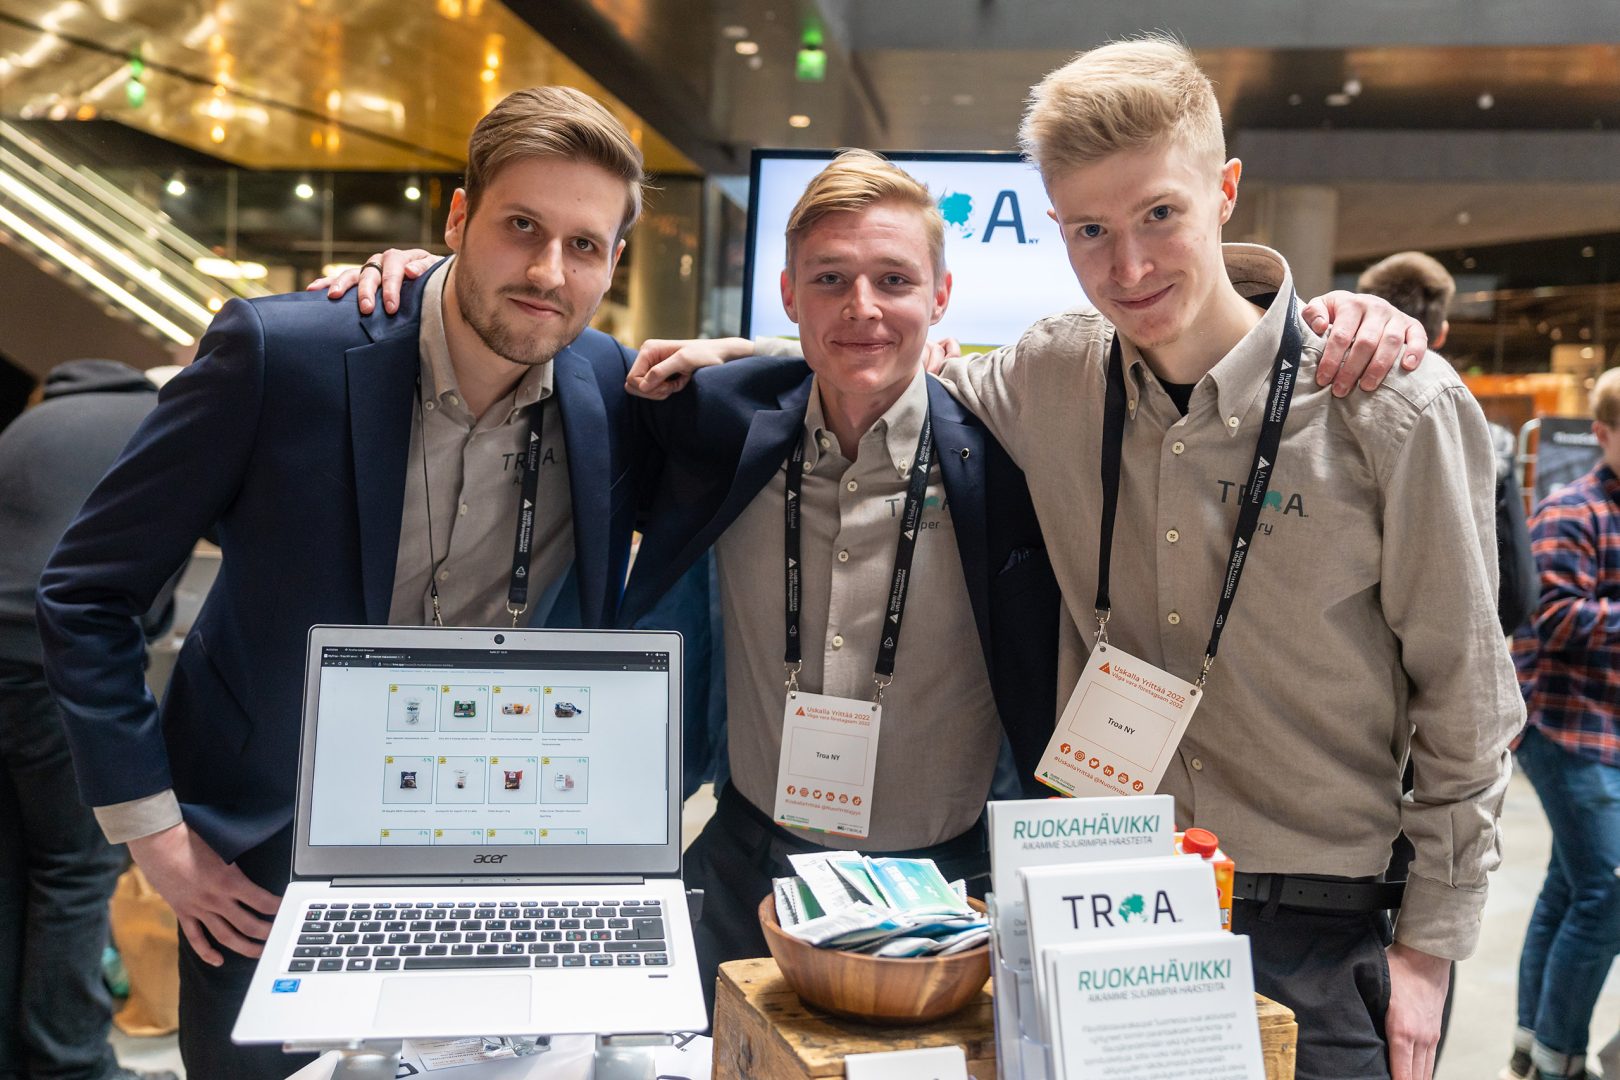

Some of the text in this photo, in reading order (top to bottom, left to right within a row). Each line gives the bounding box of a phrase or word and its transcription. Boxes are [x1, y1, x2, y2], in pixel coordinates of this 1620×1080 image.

[502, 447, 556, 471] TRA
[1252, 480, 1264, 504] Finland
[1114, 665, 1140, 681] Uskalla
[1167, 691, 1185, 703] 2022
[1169, 700, 1183, 709] 2022
[1107, 717, 1136, 735] Troa NY
[816, 752, 829, 760] Troa
[1013, 812, 1160, 839] RUOKAHÄVIKKI
[1022, 837, 1152, 850] AIKAMME SUURIMPIA HAASTEITA
[474, 854, 508, 864] acer
[1078, 959, 1231, 991] RUOKAHÄVIKKI
